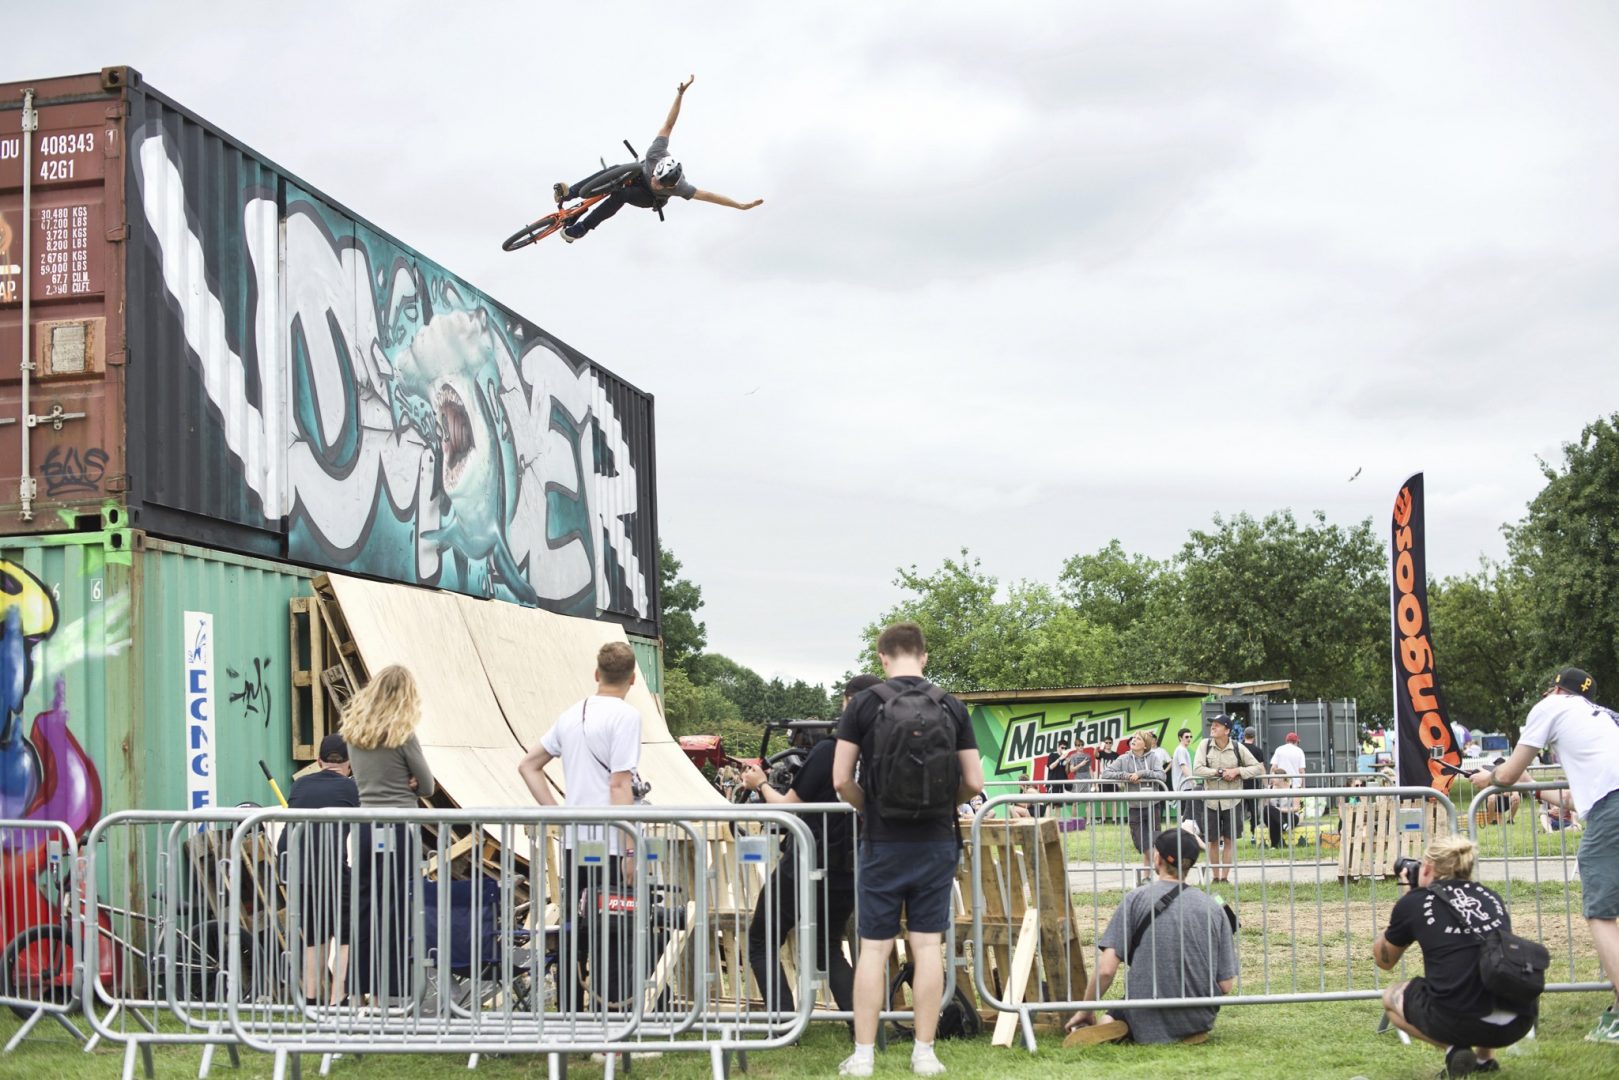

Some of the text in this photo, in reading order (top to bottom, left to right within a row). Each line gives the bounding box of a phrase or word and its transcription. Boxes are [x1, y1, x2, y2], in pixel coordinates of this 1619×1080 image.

[40, 133, 94, 156] 408343
[40, 159, 74, 180] 42G1
[72, 206, 88, 217] KGS
[72, 217, 88, 228] LBS
[72, 228, 87, 239] KGS
[72, 238, 87, 249] LBS
[72, 250, 87, 261] KGS
[72, 260, 87, 271] LBS
[93, 580, 101, 600] 6
[1008, 717, 1121, 762] Mountain
